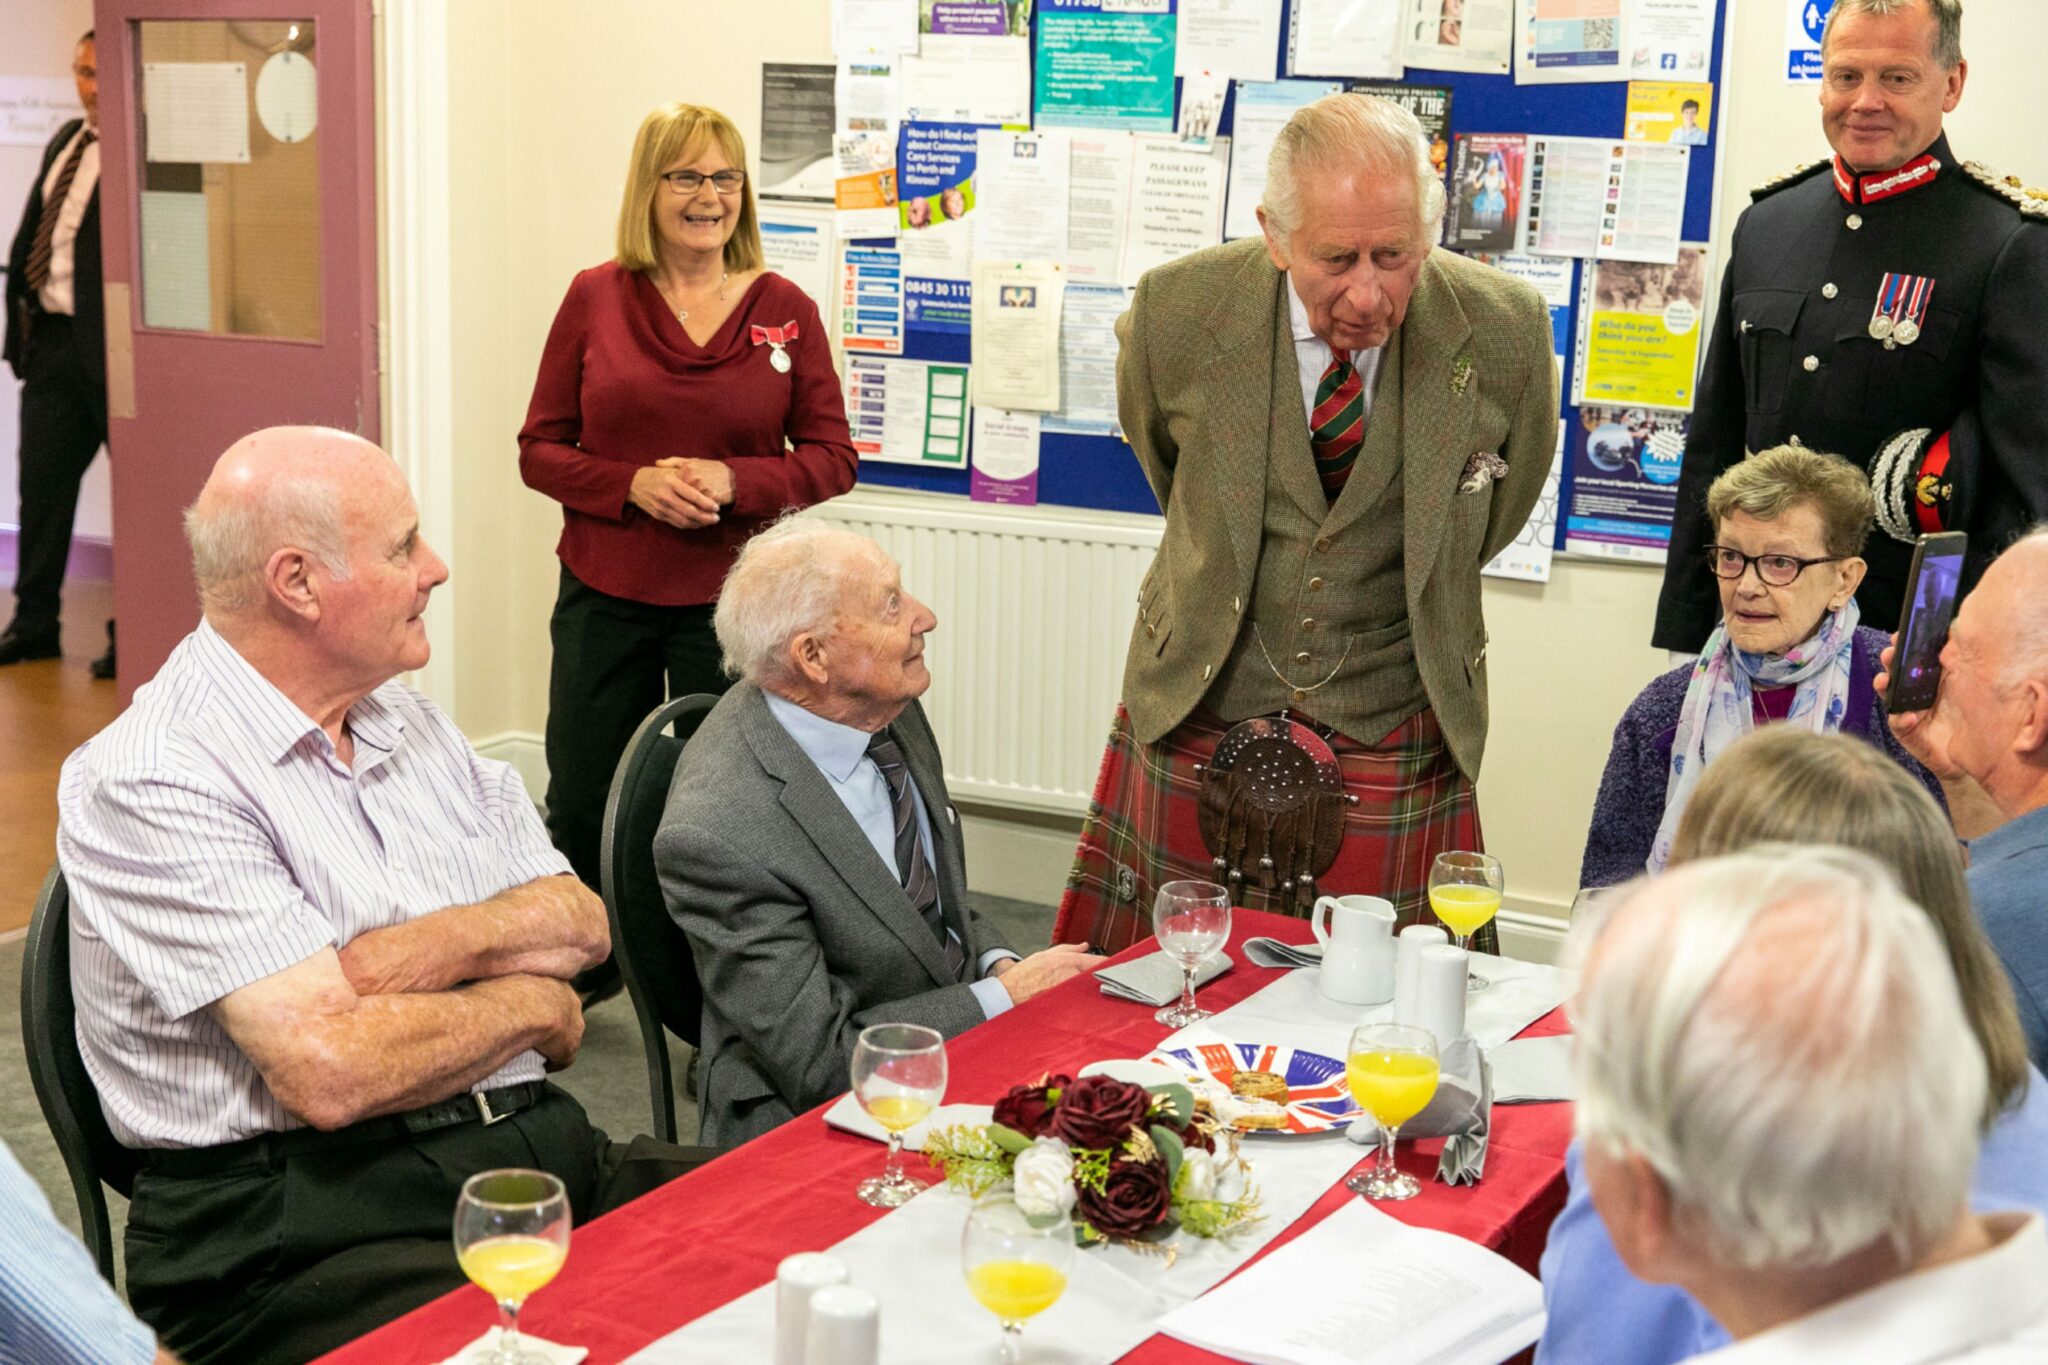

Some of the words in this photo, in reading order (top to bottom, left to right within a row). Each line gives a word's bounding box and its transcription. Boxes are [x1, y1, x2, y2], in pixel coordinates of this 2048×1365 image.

[1400, 96, 1418, 114] OF
[1420, 96, 1446, 116] THE
[907, 128, 928, 139] How
[928, 128, 939, 140] do
[944, 128, 962, 140] find
[906, 140, 932, 150] about
[906, 150, 926, 162] Care
[927, 152, 960, 164] Services
[906, 162, 916, 172] in
[916, 162, 939, 174] Perth
[940, 164, 956, 176] and
[1150, 162, 1180, 172] PLEASE
[1183, 165, 1206, 174] KEEP
[906, 174, 940, 186] Kinross?
[1499, 256, 1530, 265] Planning
[1528, 269, 1561, 278] Together
[906, 280, 934, 294] 0845
[935, 282, 950, 296] 30
[1600, 320, 1621, 330] Who
[1624, 322, 1635, 330] do
[1638, 324, 1656, 333] you
[1598, 331, 1622, 340] think
[1626, 336, 1644, 344] you
[1645, 335, 1668, 344] are?
[1596, 347, 1626, 356] Saturday
[1638, 350, 1674, 360] September
